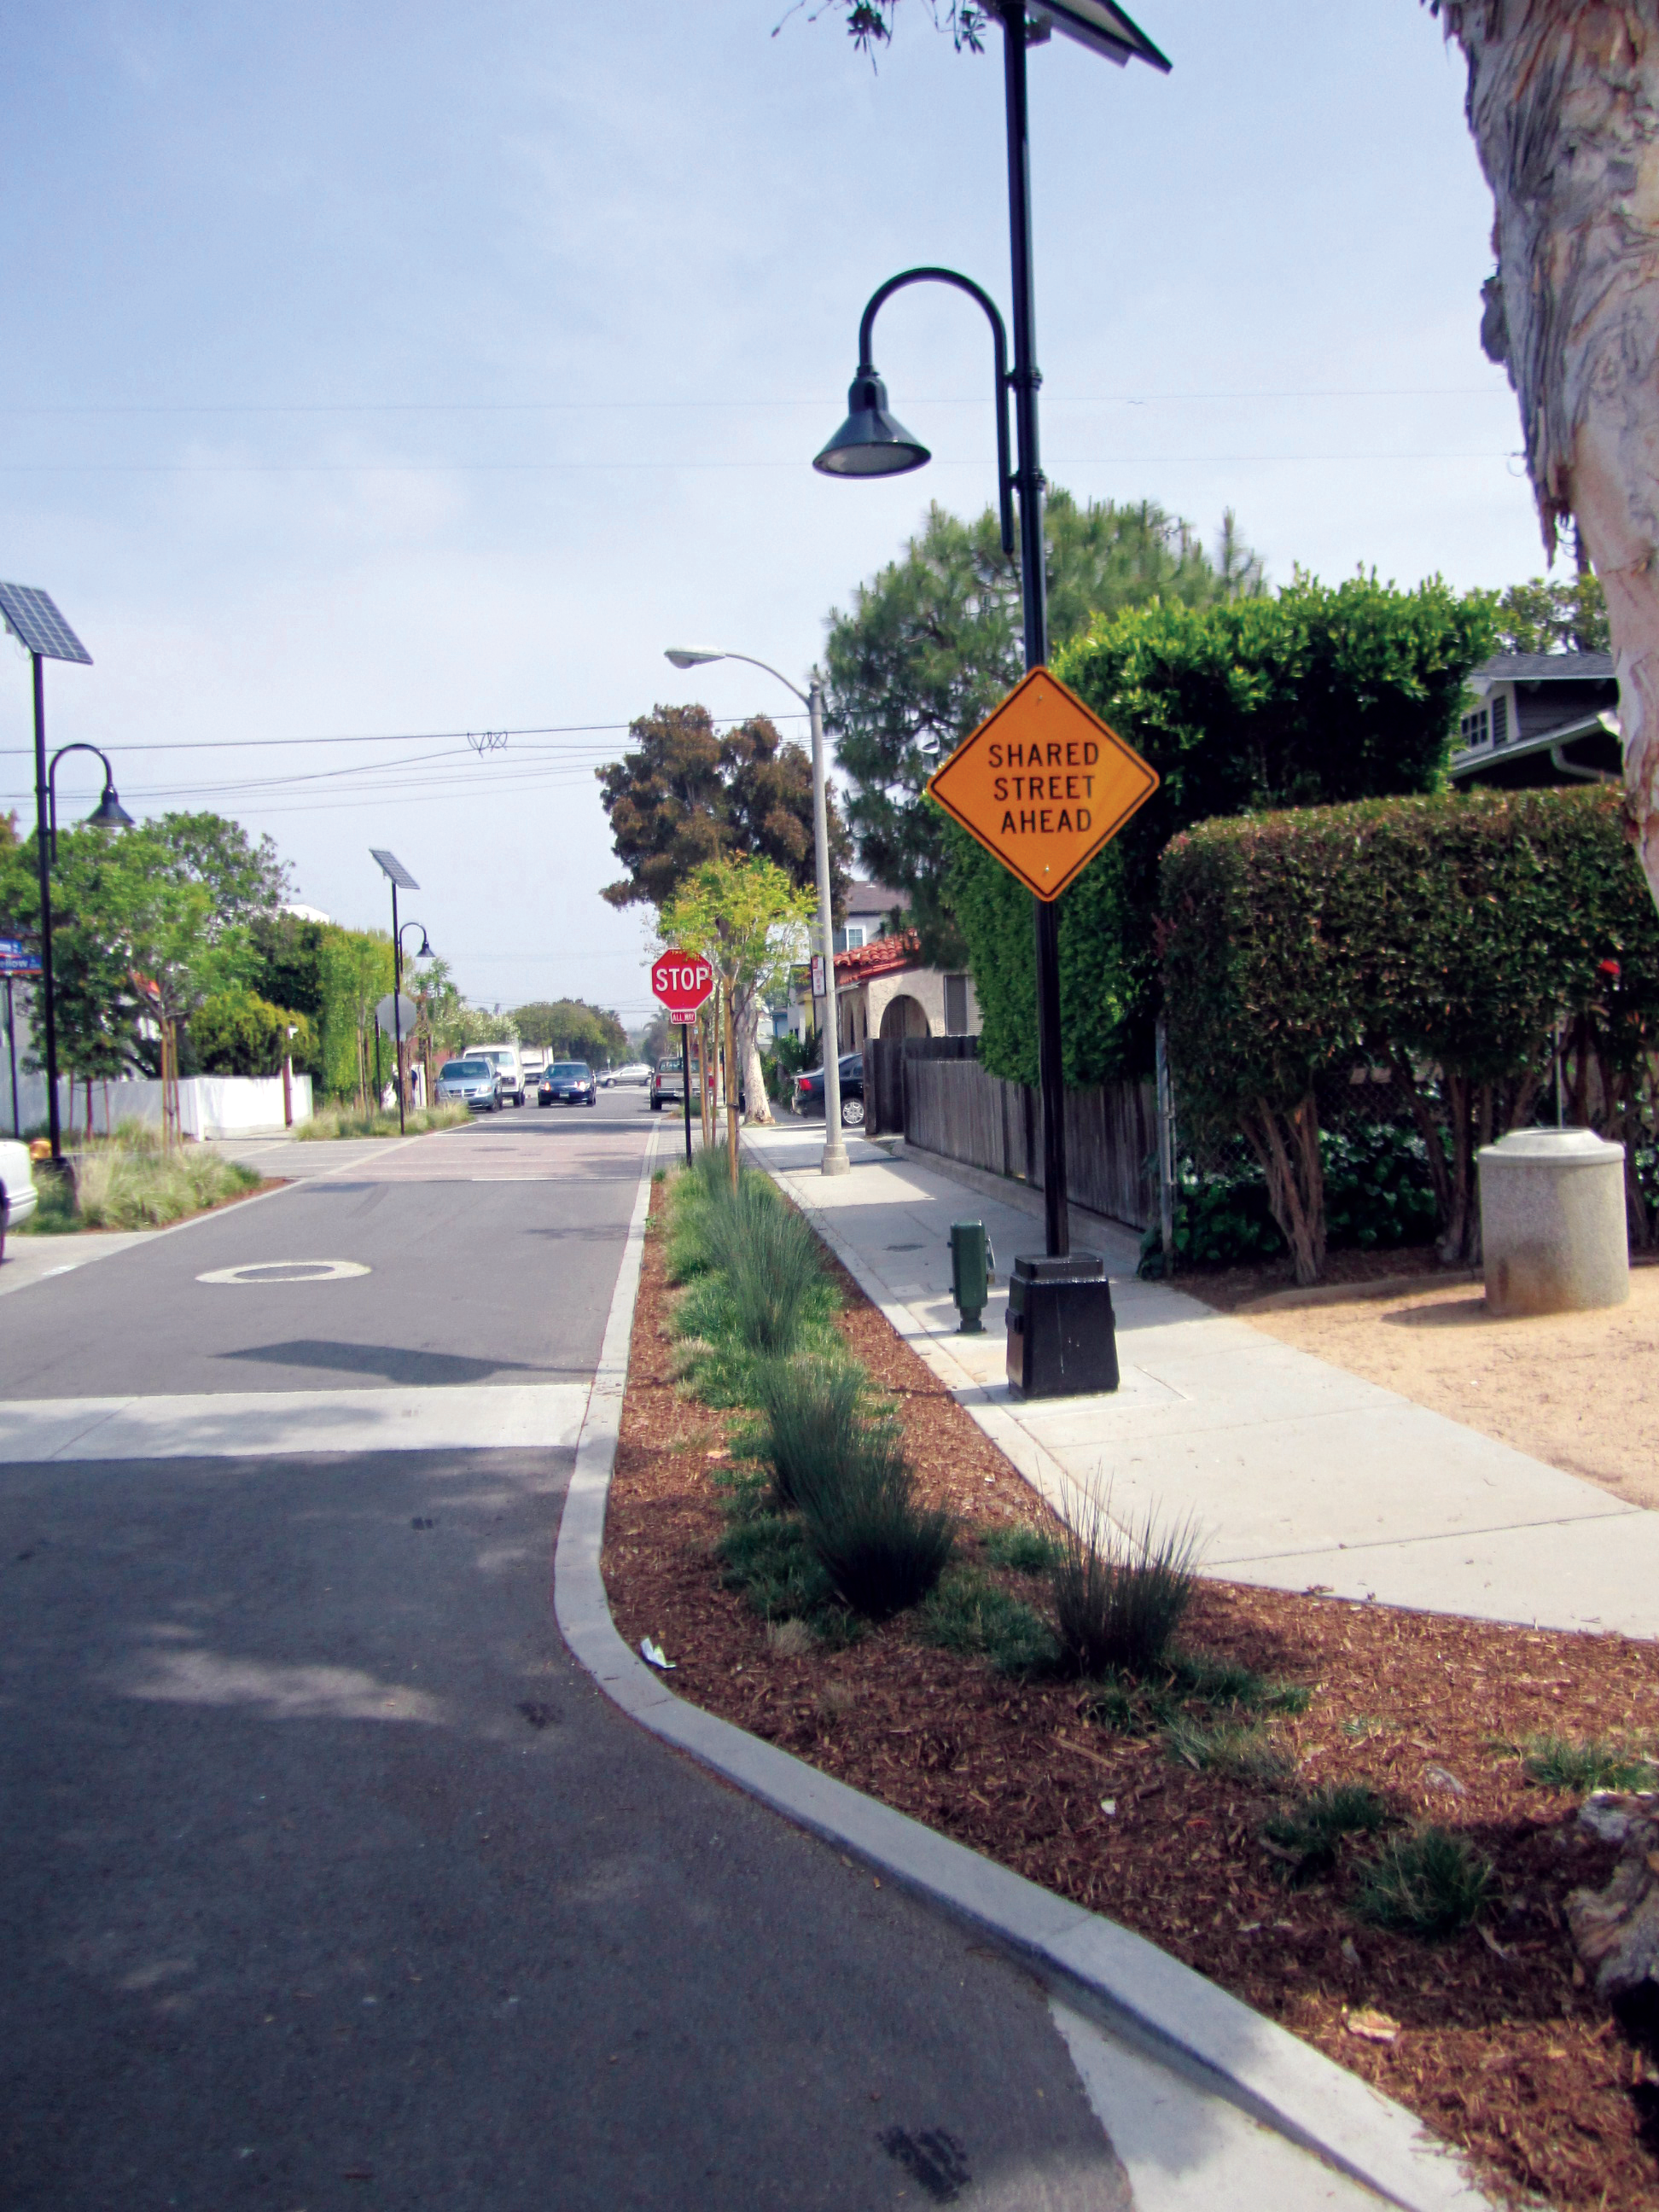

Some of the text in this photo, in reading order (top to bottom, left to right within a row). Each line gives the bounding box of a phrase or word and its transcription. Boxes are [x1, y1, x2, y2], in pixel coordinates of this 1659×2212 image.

[988, 742, 1098, 768] SHARED
[993, 775, 1096, 801] STREET
[1000, 809, 1091, 835] AHEAD
[655, 967, 709, 992] STOP
[672, 1012, 695, 1022] ALL WAY
